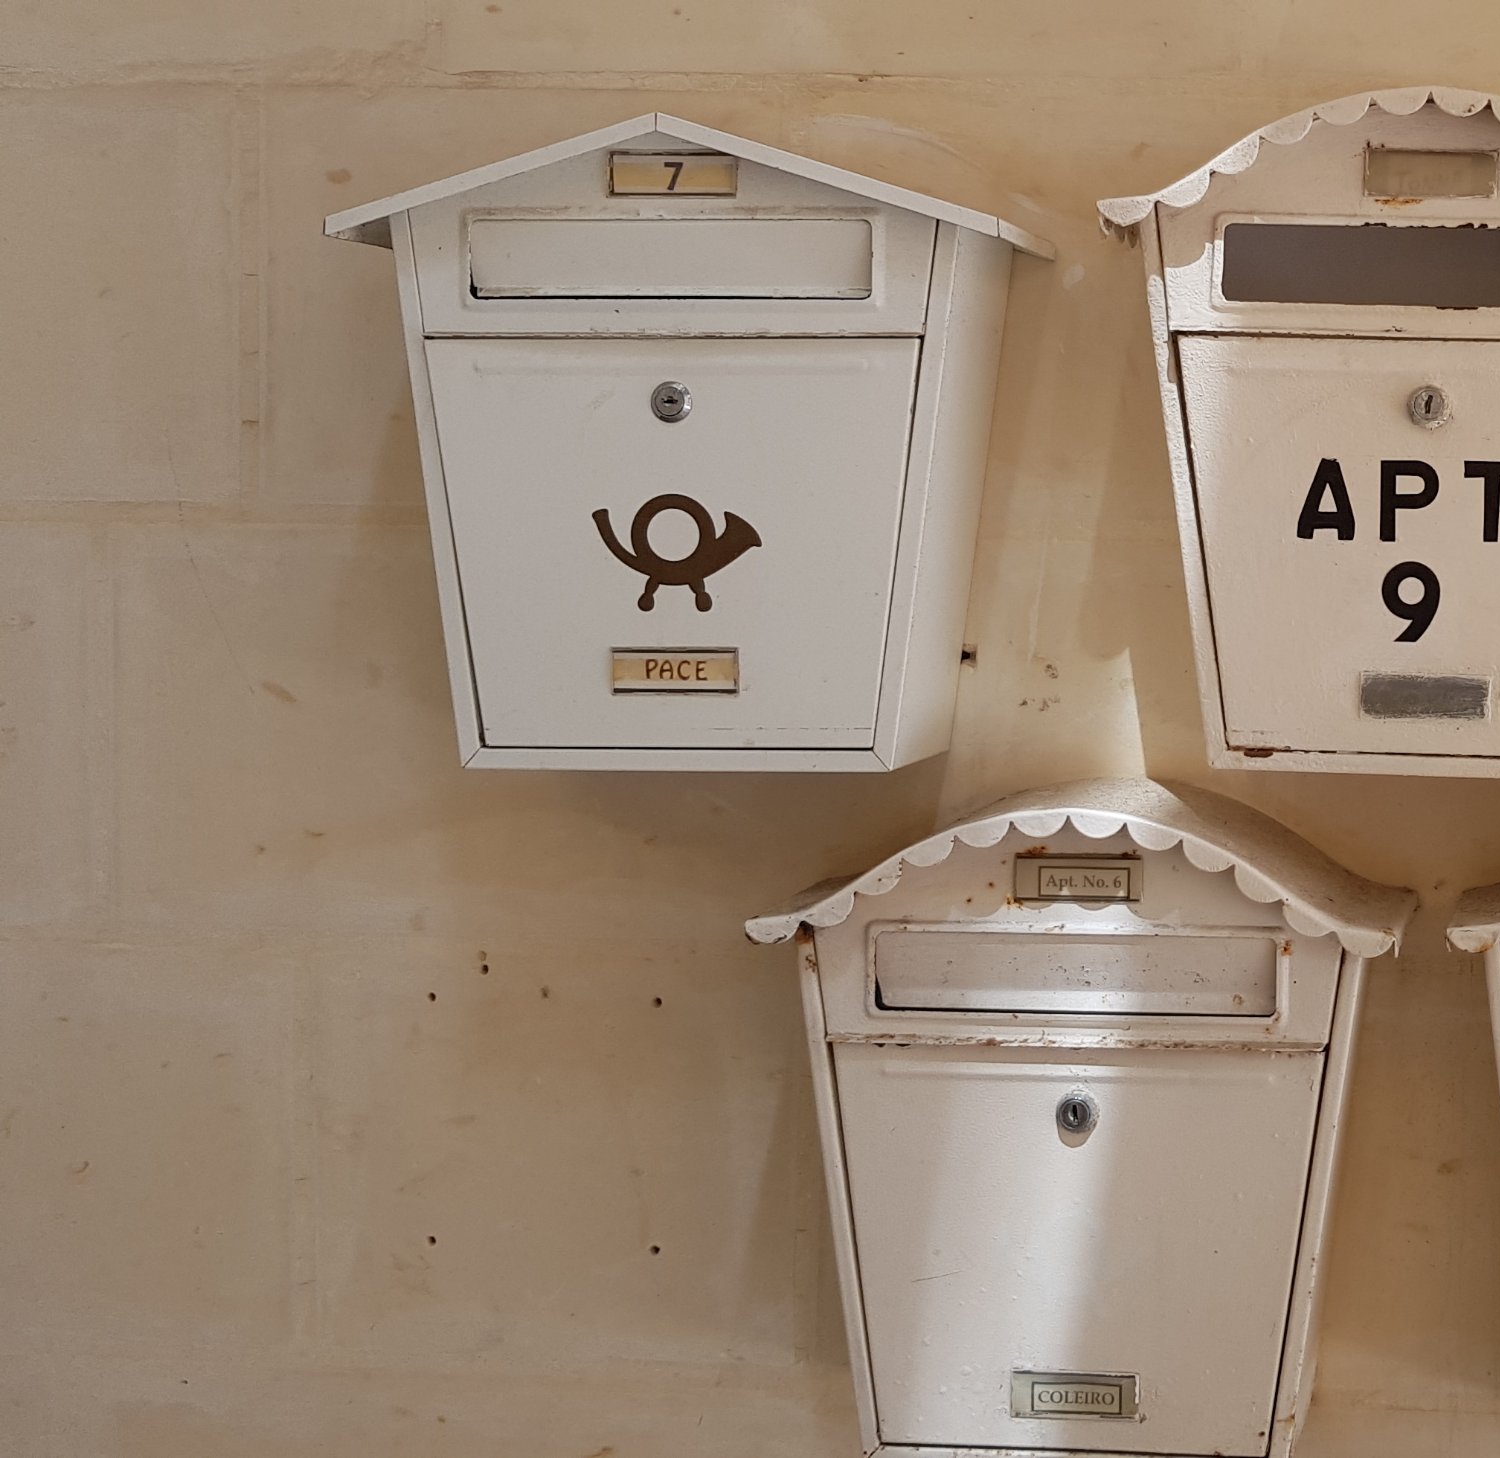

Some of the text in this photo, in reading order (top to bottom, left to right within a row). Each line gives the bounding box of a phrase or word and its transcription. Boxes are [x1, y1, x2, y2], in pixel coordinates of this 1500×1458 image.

[664, 161, 684, 192] 7
[1381, 560, 1441, 643] 9
[644, 658, 709, 682] PACE
[1045, 874, 1122, 892] Apt. No. 6
[1037, 1389, 1116, 1407] COLEIRO
